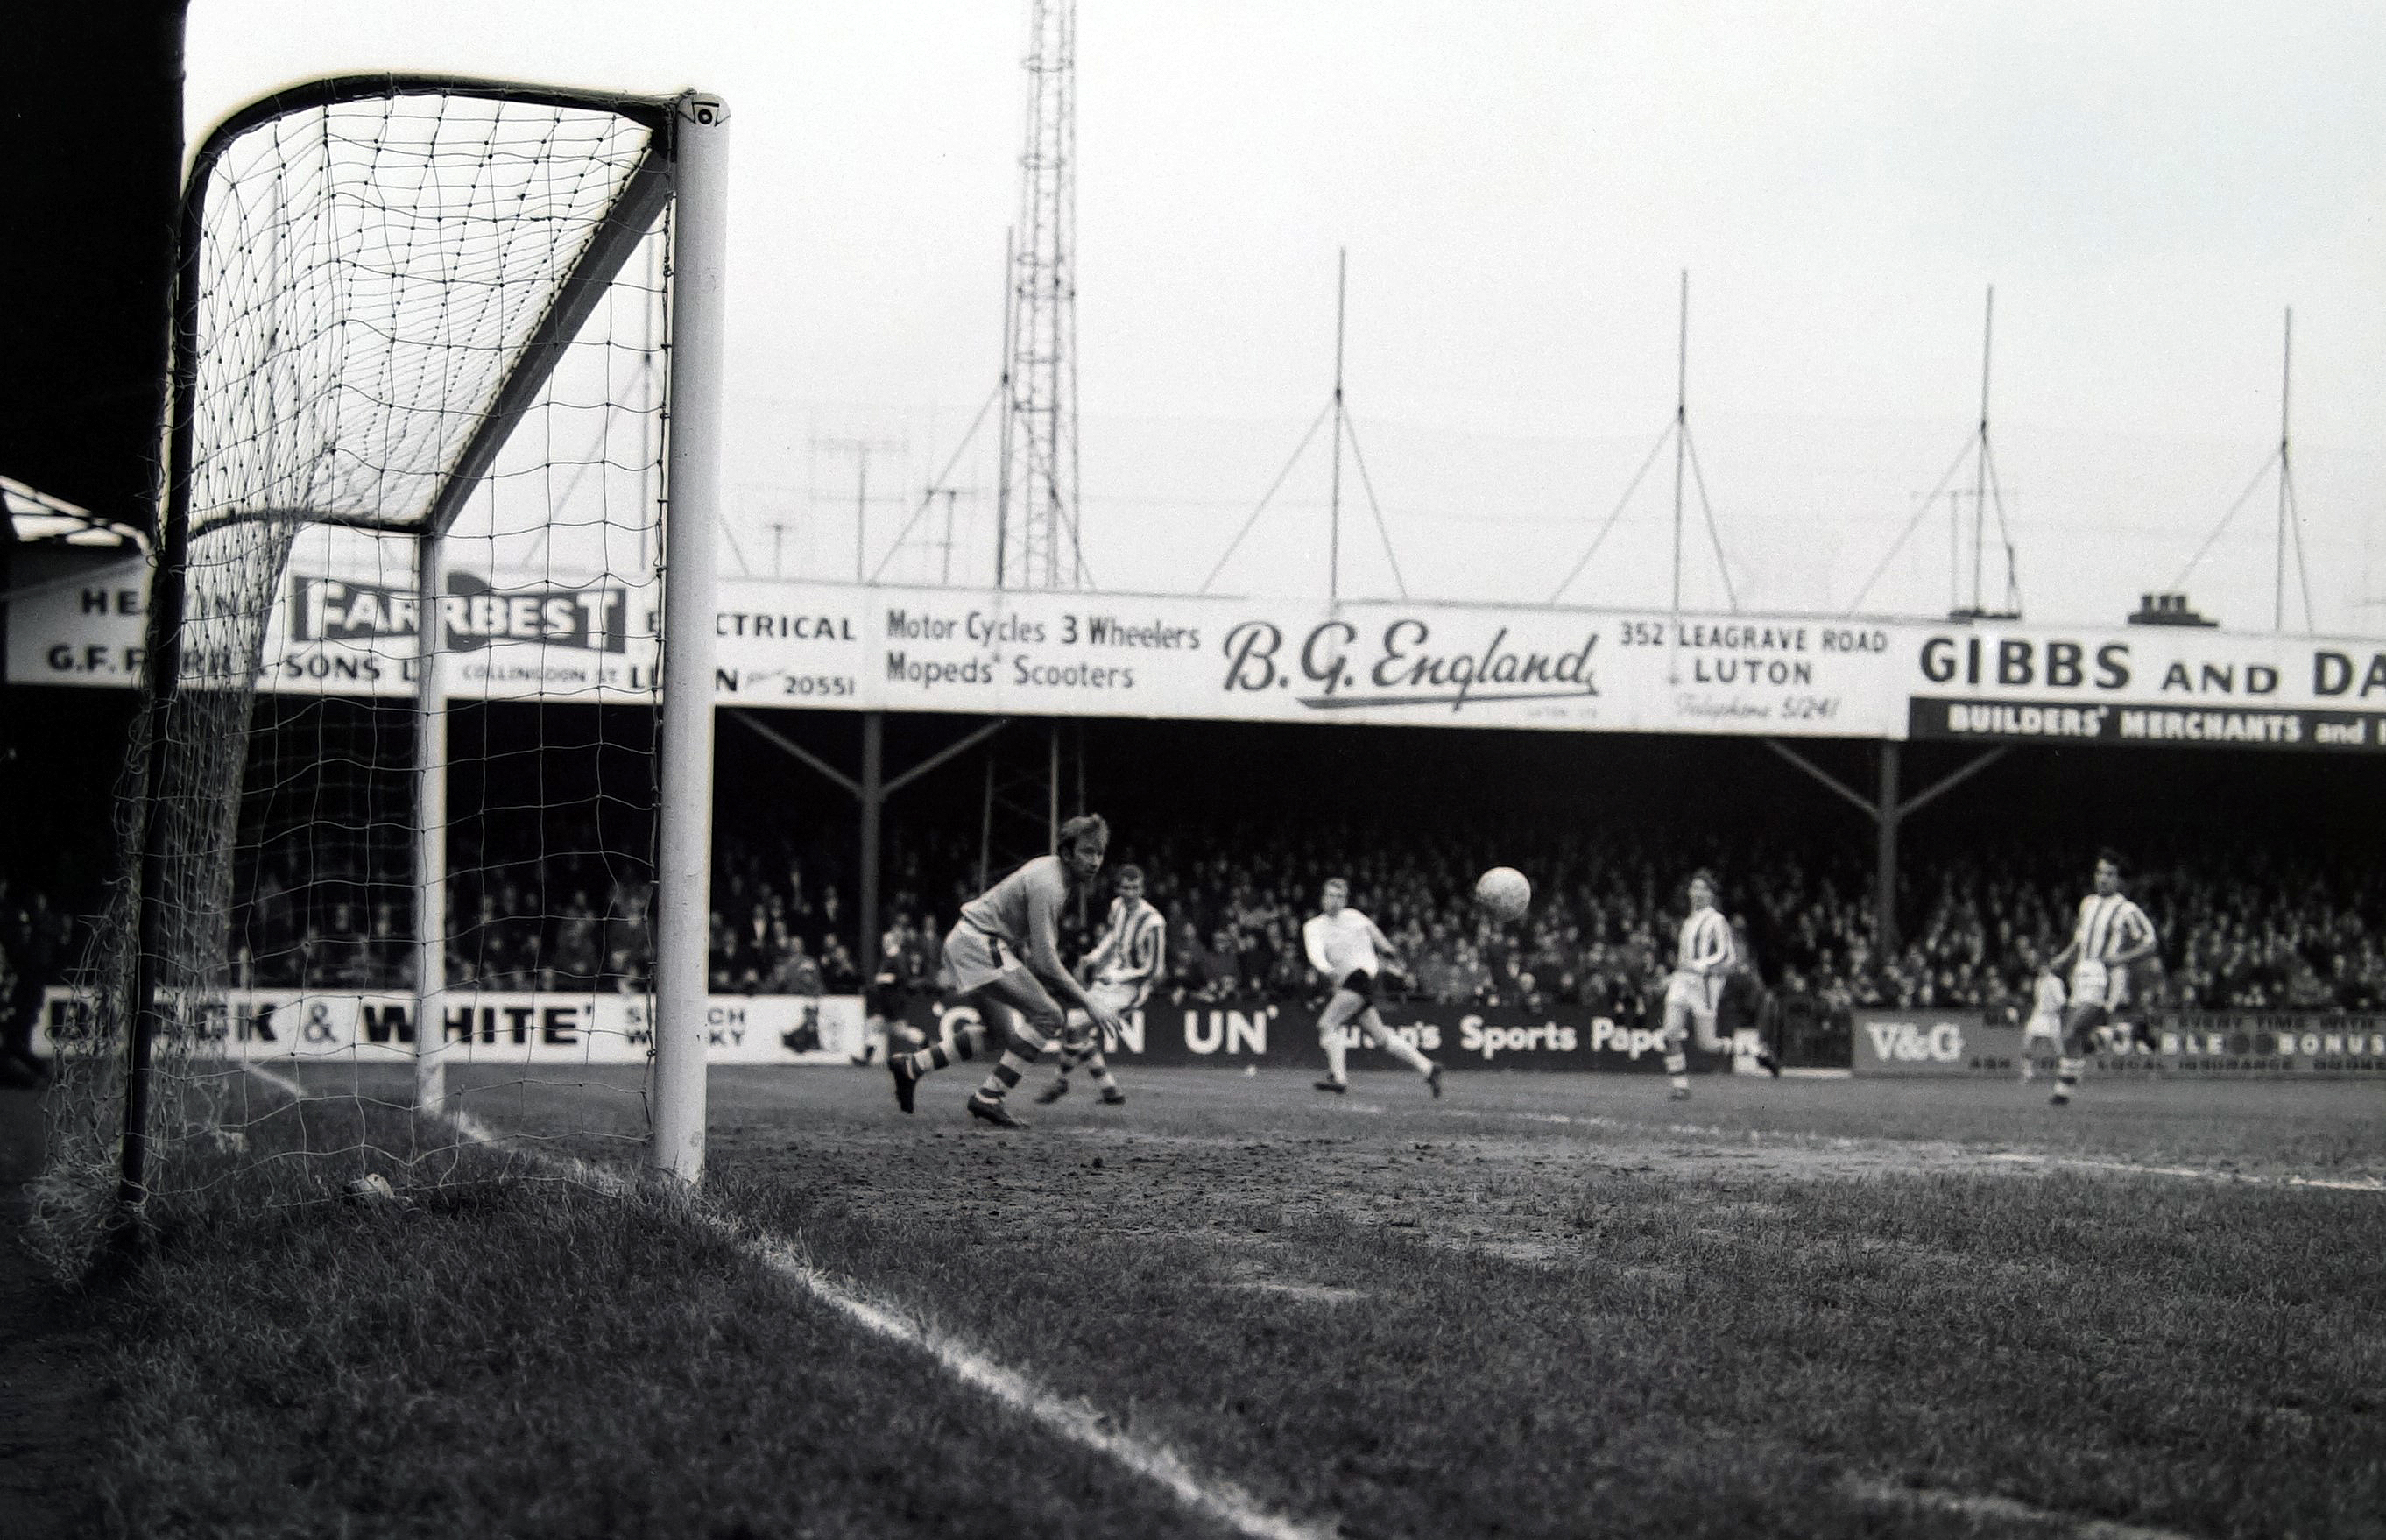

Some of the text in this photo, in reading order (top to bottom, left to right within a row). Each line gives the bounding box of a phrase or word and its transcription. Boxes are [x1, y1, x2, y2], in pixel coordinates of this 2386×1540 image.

[646, 611, 857, 641] ECTRICAL
[886, 609, 1201, 649] Motor Cycles 3 Wheelers
[1620, 621, 1888, 654] 352 LEAGRAVE ROAD
[285, 655, 380, 681] SONS
[1013, 654, 1134, 689] Scooters
[1370, 618, 1599, 713] England
[1694, 658, 1811, 686] LUTON
[1920, 637, 2131, 689] GIBBS
[2160, 662, 2279, 695] AND
[783, 675, 856, 696] 20551
[2119, 710, 2301, 744] MERCHANTS
[2313, 717, 2365, 745] and
[306, 1004, 339, 1043] &
[1459, 1014, 1577, 1060] Sports
[2278, 1032, 2385, 1056] BONUS
